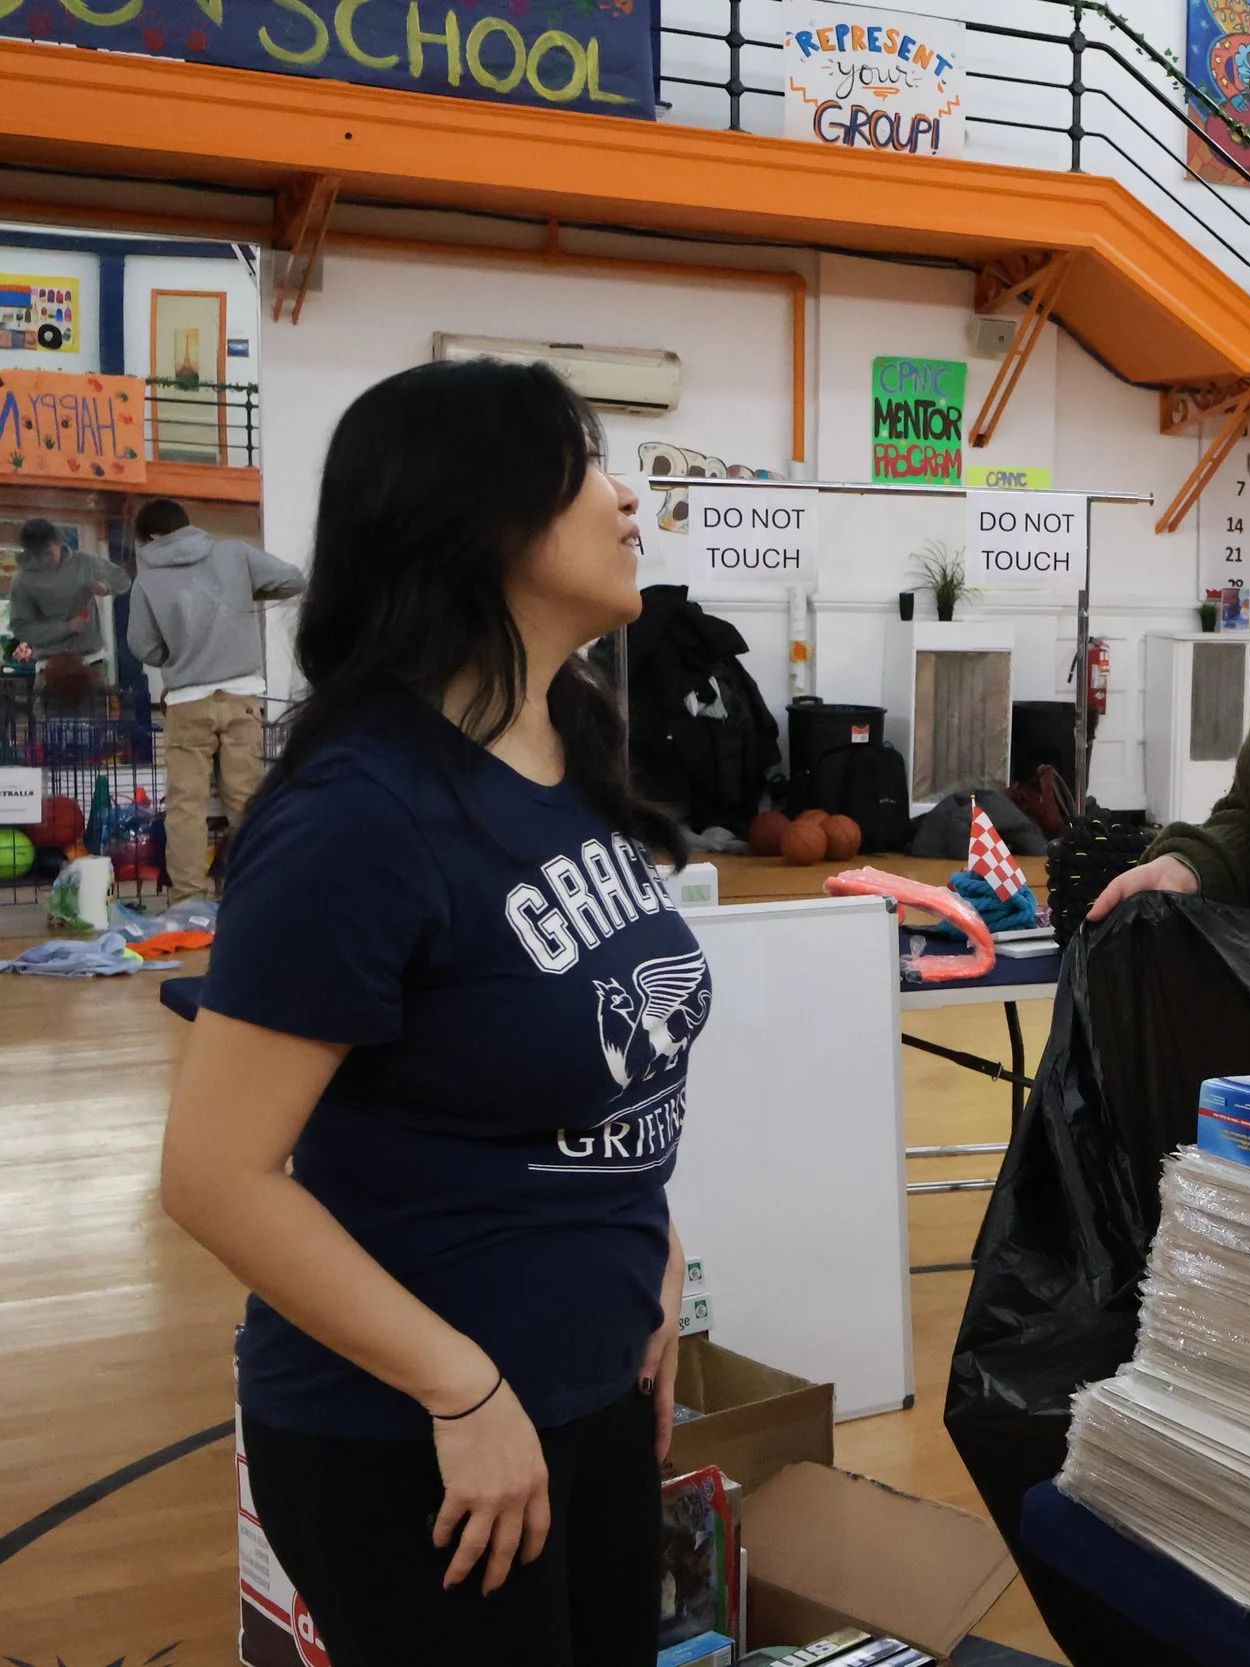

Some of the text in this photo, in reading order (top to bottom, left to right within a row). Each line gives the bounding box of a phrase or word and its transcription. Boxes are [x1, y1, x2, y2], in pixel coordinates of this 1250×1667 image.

[257, 0, 633, 103] SCHOOL
[795, 24, 953, 76] REPRESENT
[836, 61, 914, 99] your
[814, 100, 940, 155] GROUP!
[880, 360, 952, 397] CPNYC
[874, 397, 962, 440] MENTOR
[873, 443, 962, 479] PROGRAM
[1236, 481, 1246, 496] 7
[704, 507, 805, 529] DO NOT
[979, 511, 1074, 534] DO NOT
[1226, 517, 1243, 533] 14
[706, 548, 800, 569] TOUCH
[982, 550, 1071, 572] TOUCH
[1225, 547, 1243, 562] 21
